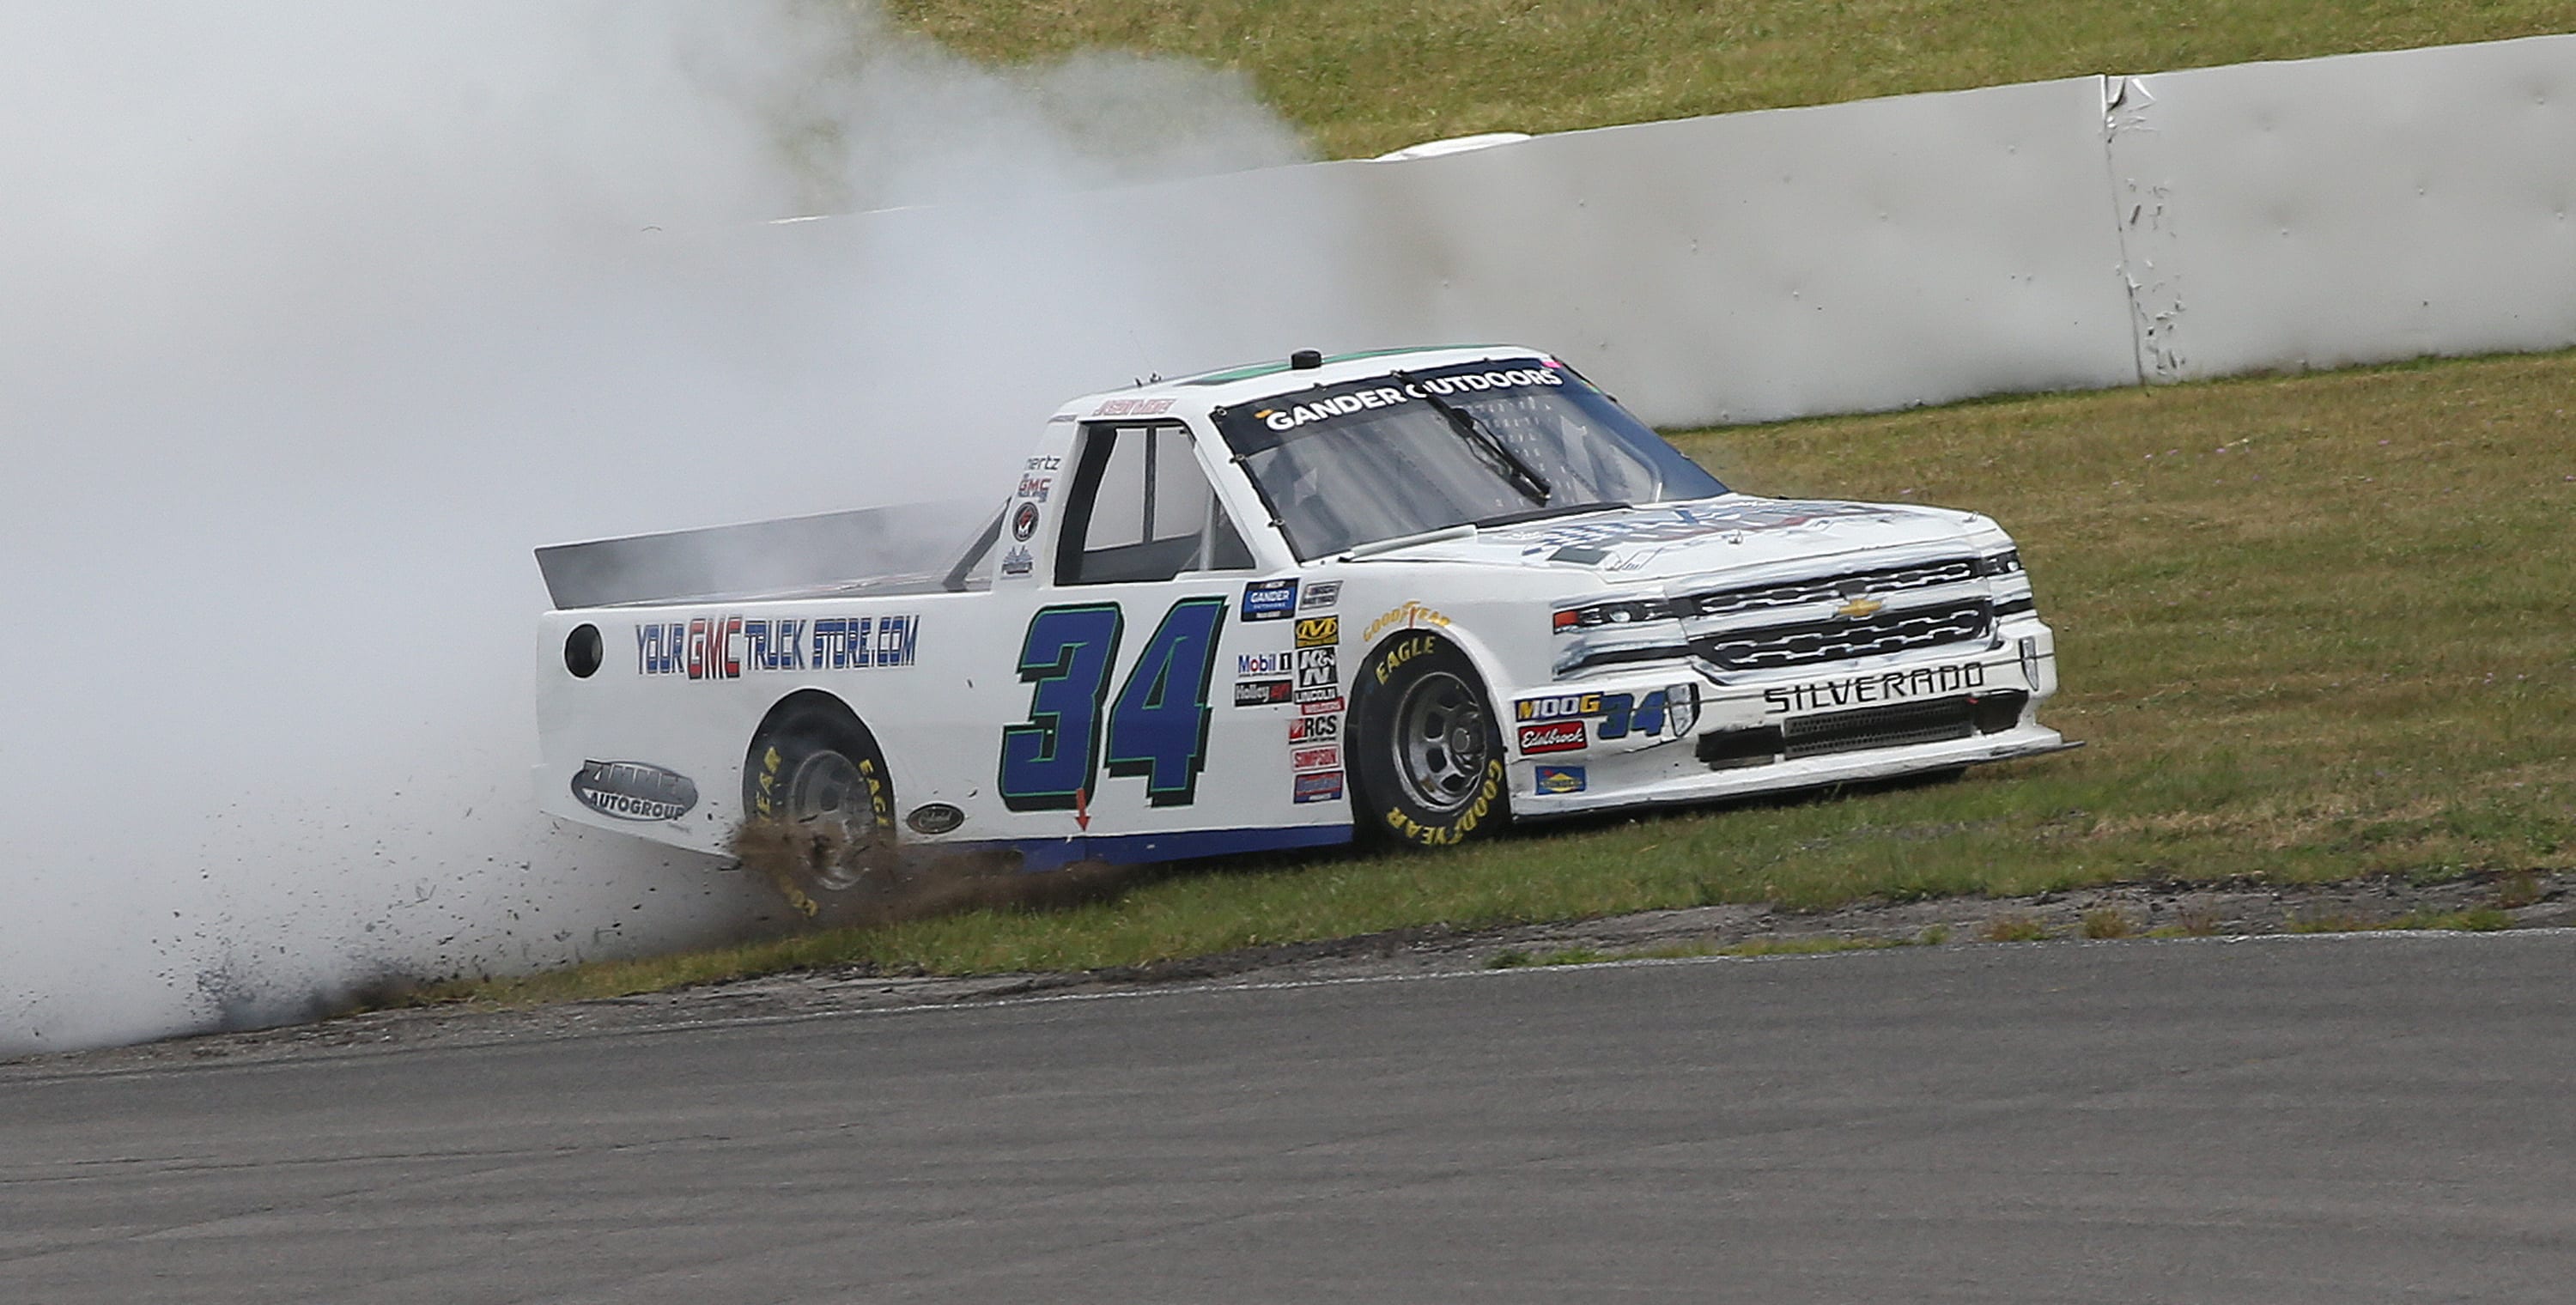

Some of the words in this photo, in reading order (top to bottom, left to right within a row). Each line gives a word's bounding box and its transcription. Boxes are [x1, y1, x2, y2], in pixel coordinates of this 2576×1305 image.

[1265, 388, 1408, 431] GANDER
[1408, 369, 1563, 398] OUTDOORS
[1251, 590, 1290, 603] GANDER
[635, 622, 685, 675] YOUR
[688, 615, 743, 680] GMC
[744, 618, 807, 671] TRUCK
[811, 615, 920, 671] STORE.COM
[1238, 653, 1276, 673] Mobil
[1375, 635, 1436, 685] EAGLE
[997, 595, 1230, 812] 34
[1236, 683, 1270, 702] Holley
[1518, 694, 1601, 719] MOOG
[1764, 661, 1984, 714] SILVERADO
[1305, 715, 1337, 737] RCS
[1597, 689, 1668, 741] 34
[1522, 727, 1584, 748] Edelbrock
[590, 791, 686, 821] AUTOGROUP
[1386, 758, 1503, 846] GOODYEAR
